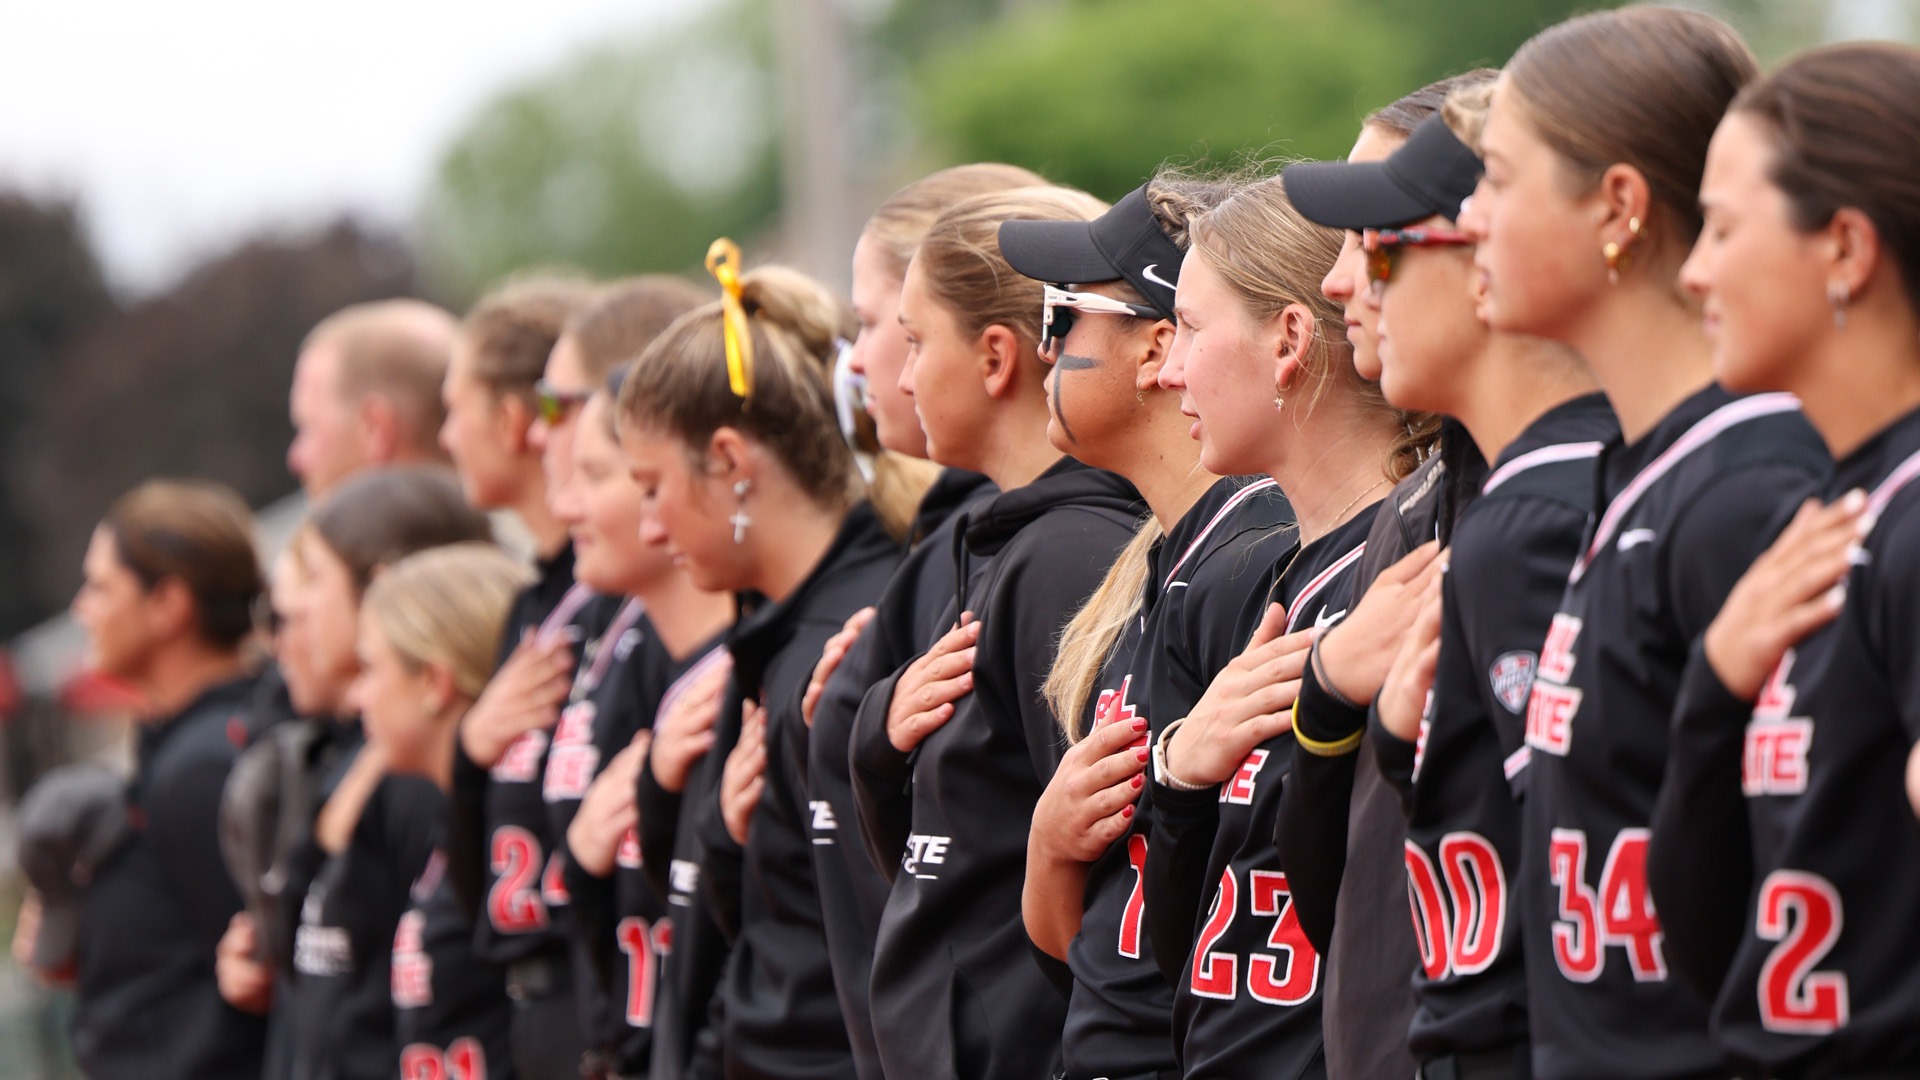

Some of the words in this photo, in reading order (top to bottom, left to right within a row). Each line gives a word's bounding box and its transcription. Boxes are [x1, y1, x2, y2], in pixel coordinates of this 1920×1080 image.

[1191, 864, 1320, 1006] 23
[1405, 831, 1507, 981] 00
[1550, 827, 1667, 983] 34
[1756, 869, 1849, 1035] 2
